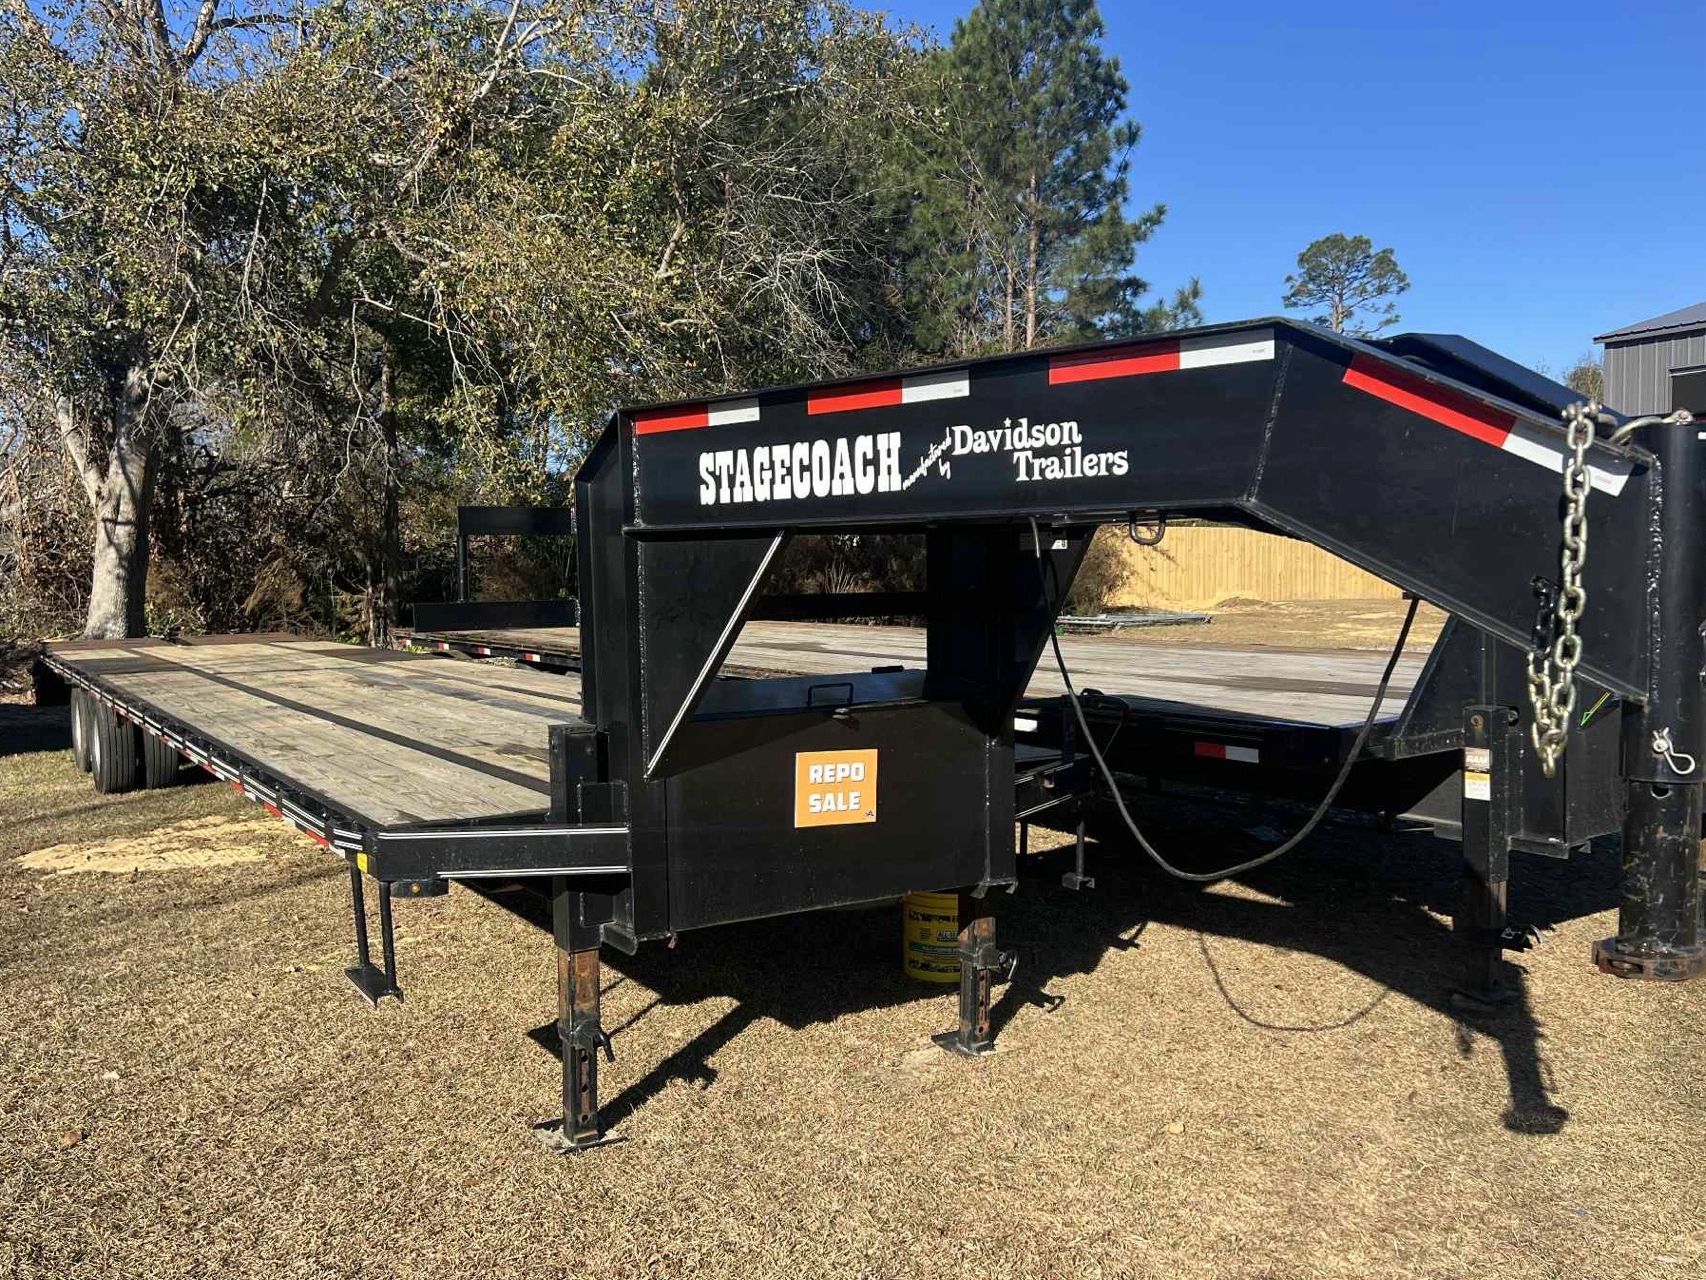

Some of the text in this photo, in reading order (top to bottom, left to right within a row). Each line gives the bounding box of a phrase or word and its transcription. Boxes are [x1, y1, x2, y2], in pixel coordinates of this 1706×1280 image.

[952, 417, 1082, 456] Davidson
[699, 432, 902, 505] STAGECOACH
[1013, 447, 1129, 482] Trailers
[809, 763, 865, 784] REPO
[808, 792, 861, 813] SALE
